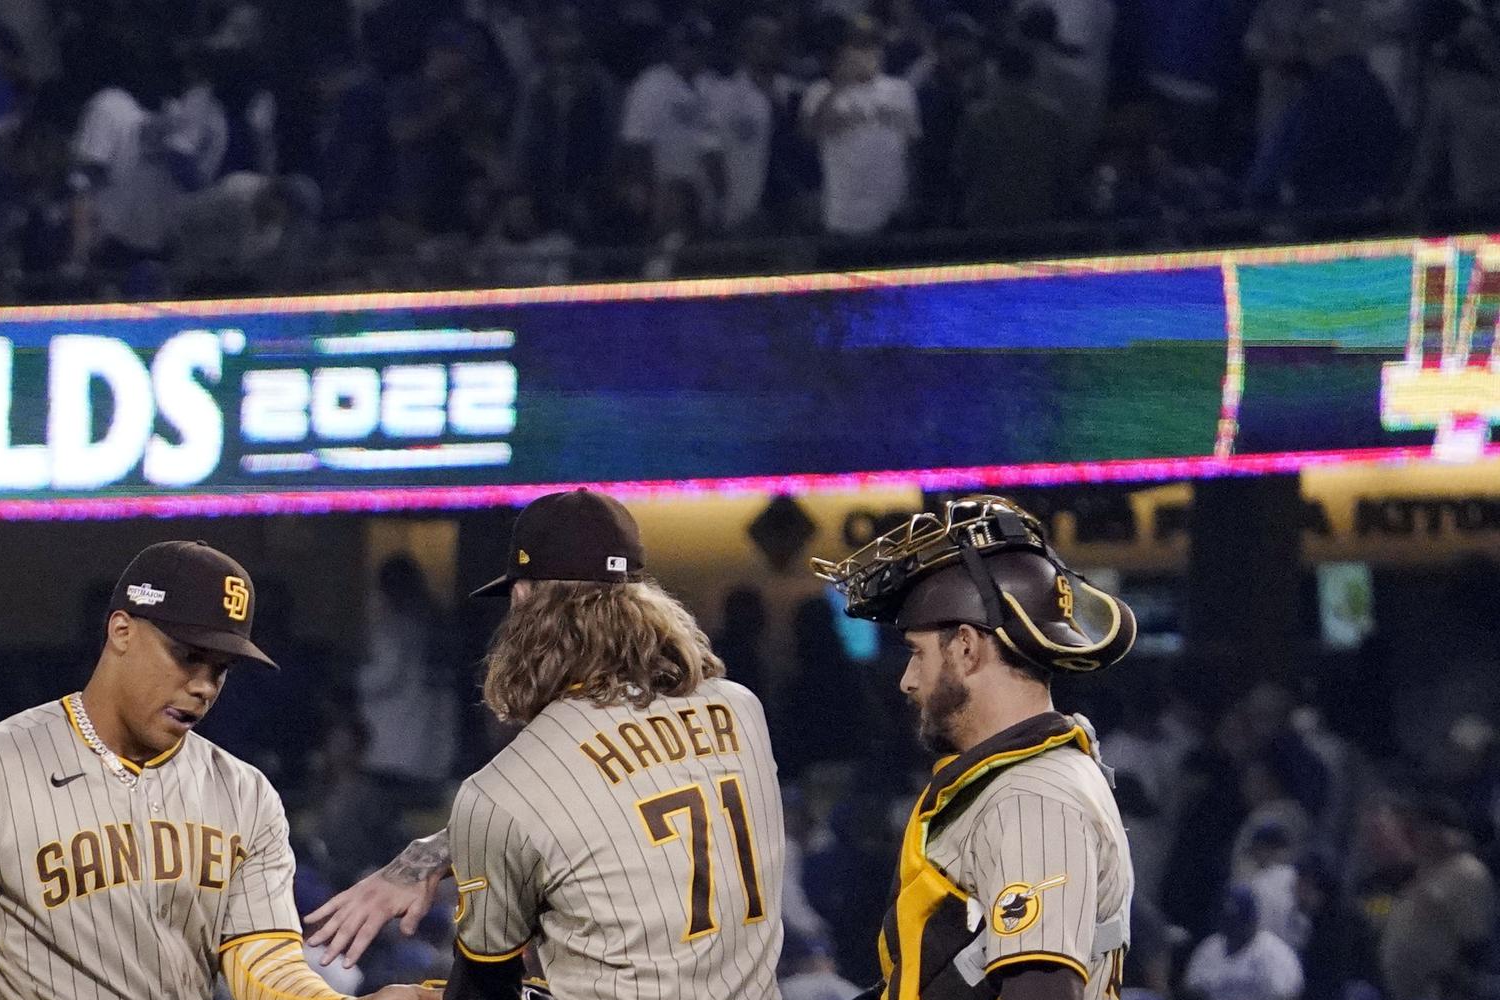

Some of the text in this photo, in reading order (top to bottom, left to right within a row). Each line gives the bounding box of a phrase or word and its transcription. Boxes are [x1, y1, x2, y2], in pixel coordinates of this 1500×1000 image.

[241, 361, 516, 443] 2022
[223, 576, 249, 621] SD
[579, 703, 740, 785] HADER
[36, 822, 142, 910] SAN
[634, 774, 766, 945] 71
